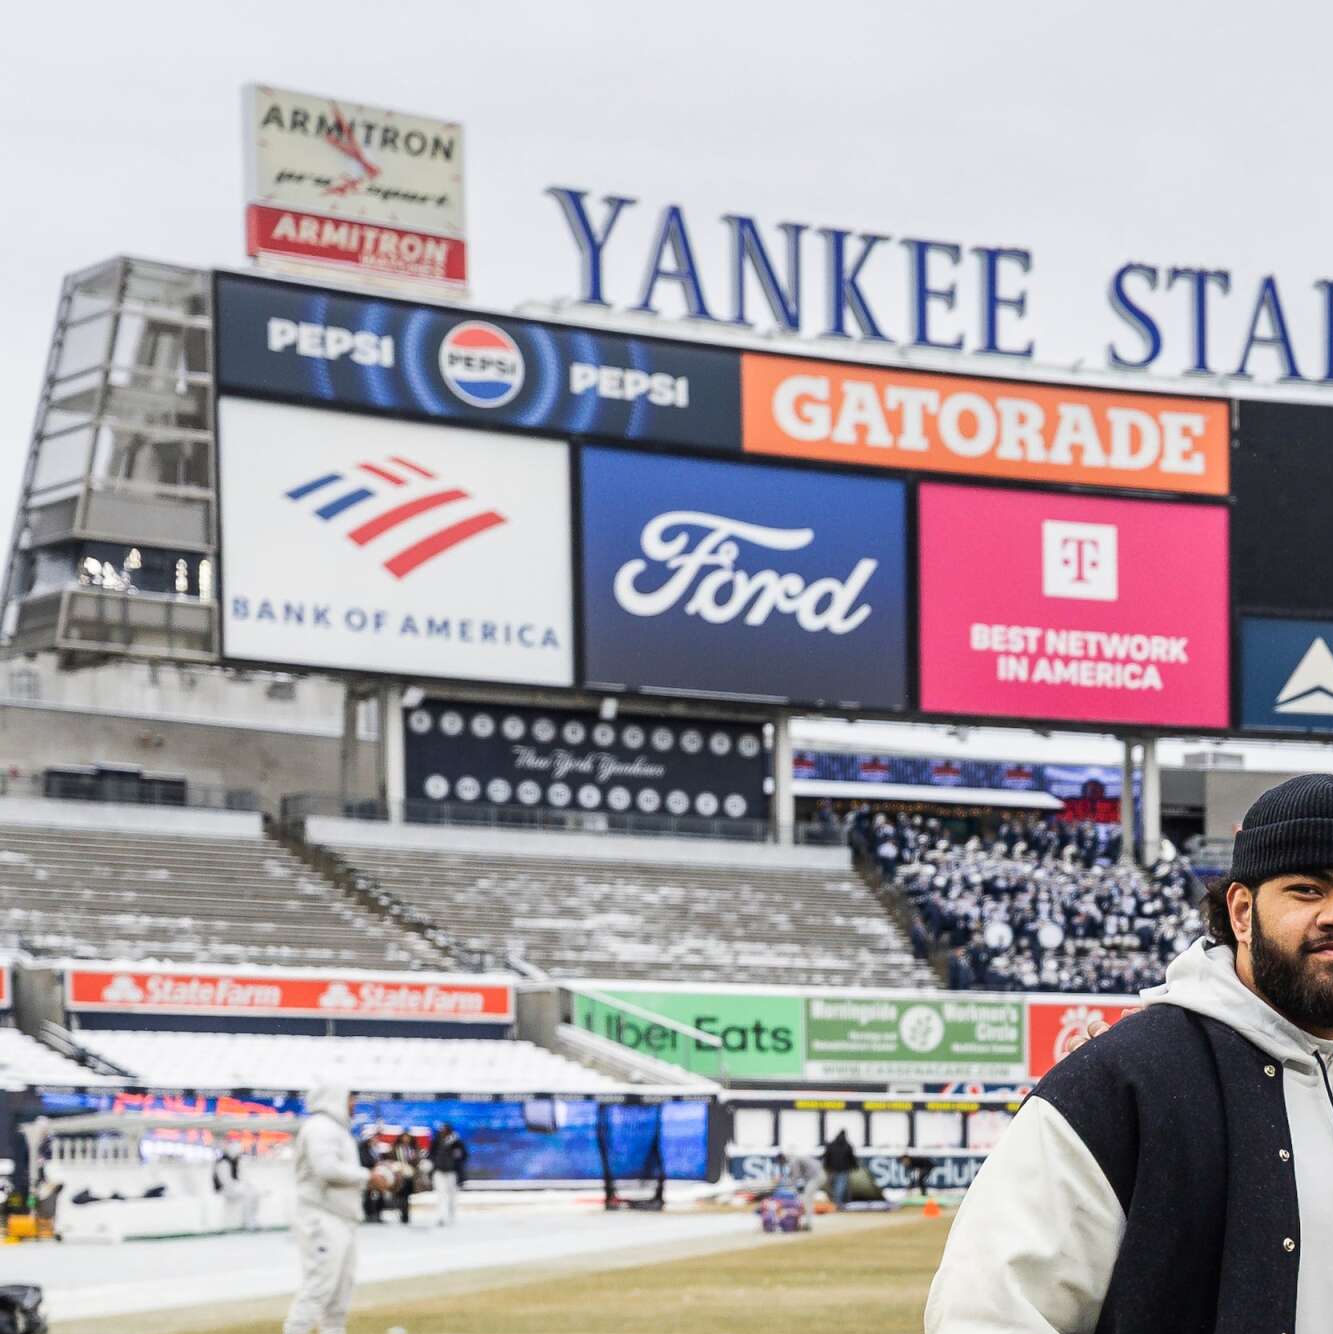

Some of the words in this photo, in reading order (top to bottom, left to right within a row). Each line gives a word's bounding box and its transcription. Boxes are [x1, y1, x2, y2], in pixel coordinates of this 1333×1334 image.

[262, 104, 454, 160] ARMITRON
[271, 212, 450, 266] ARMITRON
[544, 186, 1035, 359] YANKEE
[267, 317, 394, 367] PEPSI
[447, 351, 518, 378] PEPSI
[570, 363, 689, 408] PEPSI
[771, 374, 1206, 475] GATORADE
[613, 510, 878, 635] Ford
[232, 596, 332, 629] BANK
[345, 608, 388, 635] OF
[399, 613, 562, 650] AMERICA
[971, 622, 1040, 653] BEST
[1045, 626, 1189, 663] NETWORK
[997, 654, 1029, 683] IN
[1034, 656, 1162, 692] AMERICA
[693, 1014, 794, 1054] Eats
